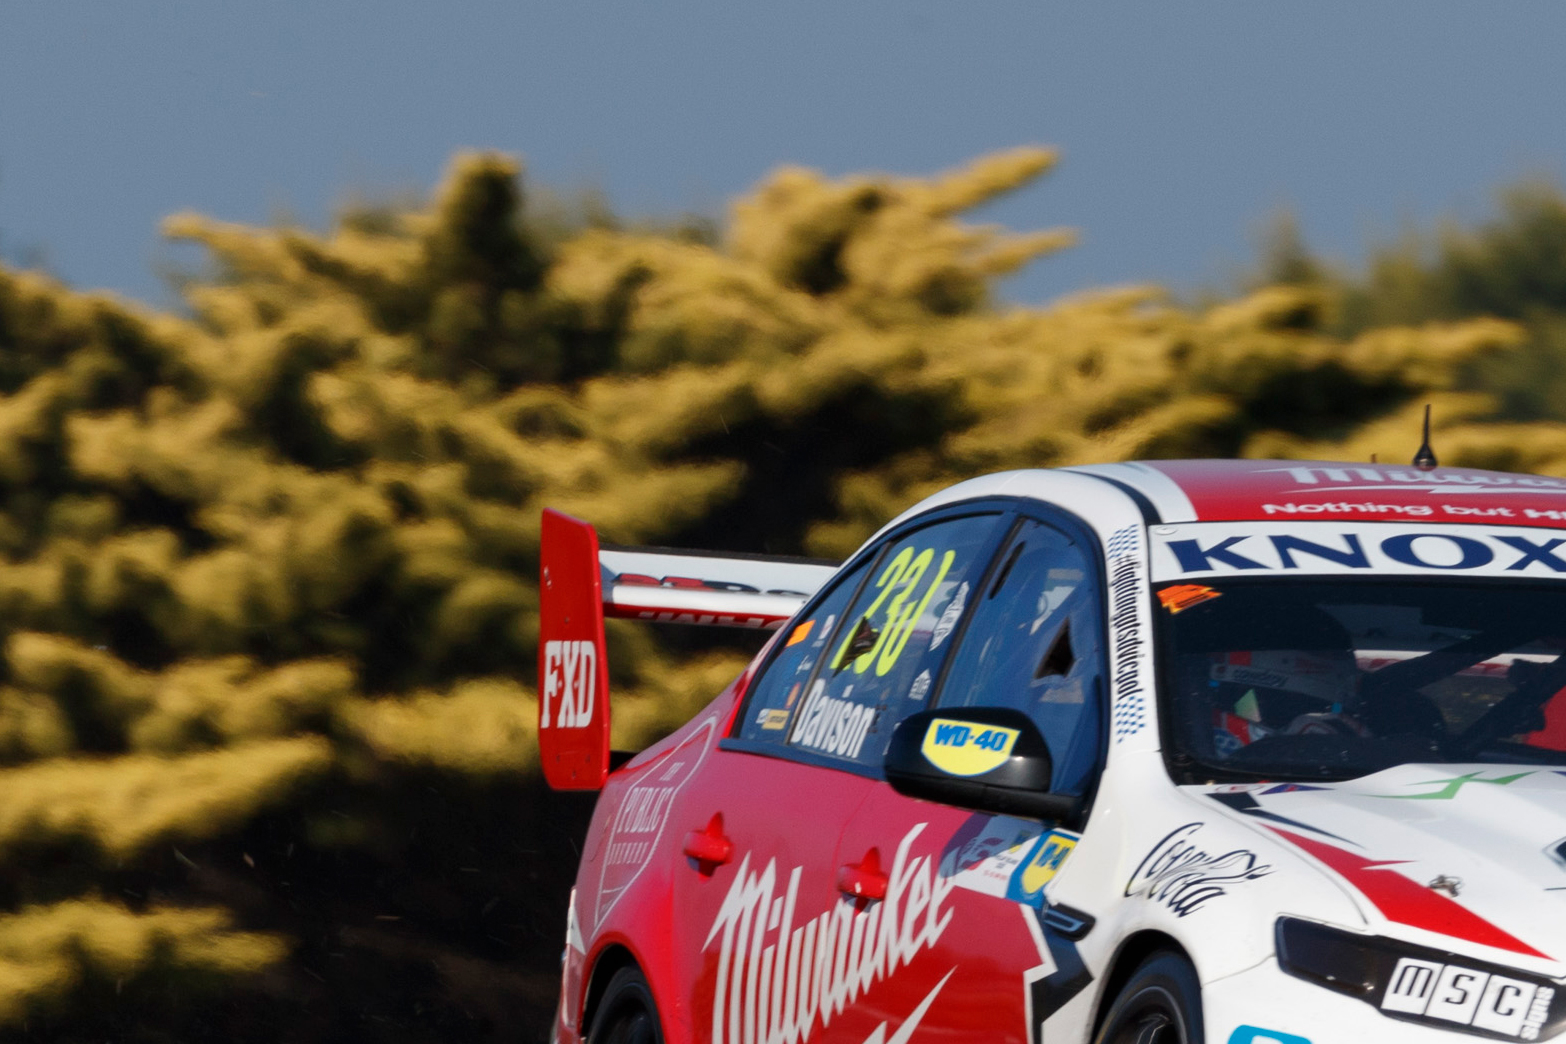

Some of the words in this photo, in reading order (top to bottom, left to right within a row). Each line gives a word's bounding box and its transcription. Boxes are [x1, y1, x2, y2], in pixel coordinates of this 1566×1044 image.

[1261, 501, 1434, 517] Nothing
[1441, 503, 1517, 518] but
[790, 678, 878, 759] Davison
[934, 723, 1009, 752] WD-40
[616, 786, 674, 834] PUBLIC
[1392, 964, 1522, 1017] MSC
